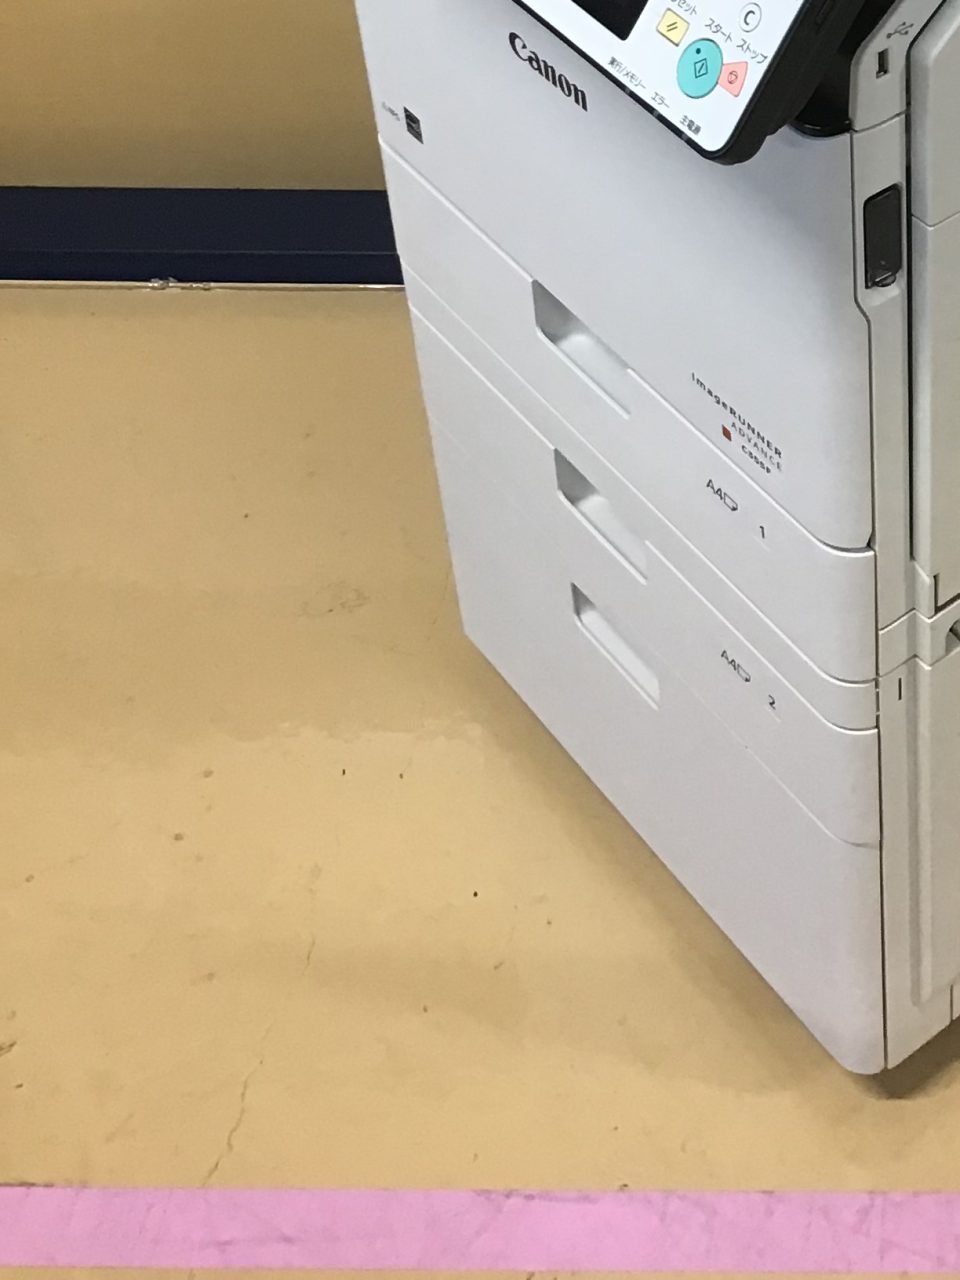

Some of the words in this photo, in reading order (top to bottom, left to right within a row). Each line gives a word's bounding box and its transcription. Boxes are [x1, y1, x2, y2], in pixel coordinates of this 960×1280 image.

[704, 17, 733, 43] スタート
[743, 10, 756, 26] C
[736, 38, 768, 65] ストップ
[508, 31, 588, 112] Canon
[651, 92, 670, 109] エラー
[706, 479, 723, 500] A4
[759, 525, 766, 539] 1
[720, 649, 737, 671] A4
[767, 694, 777, 711] 2
